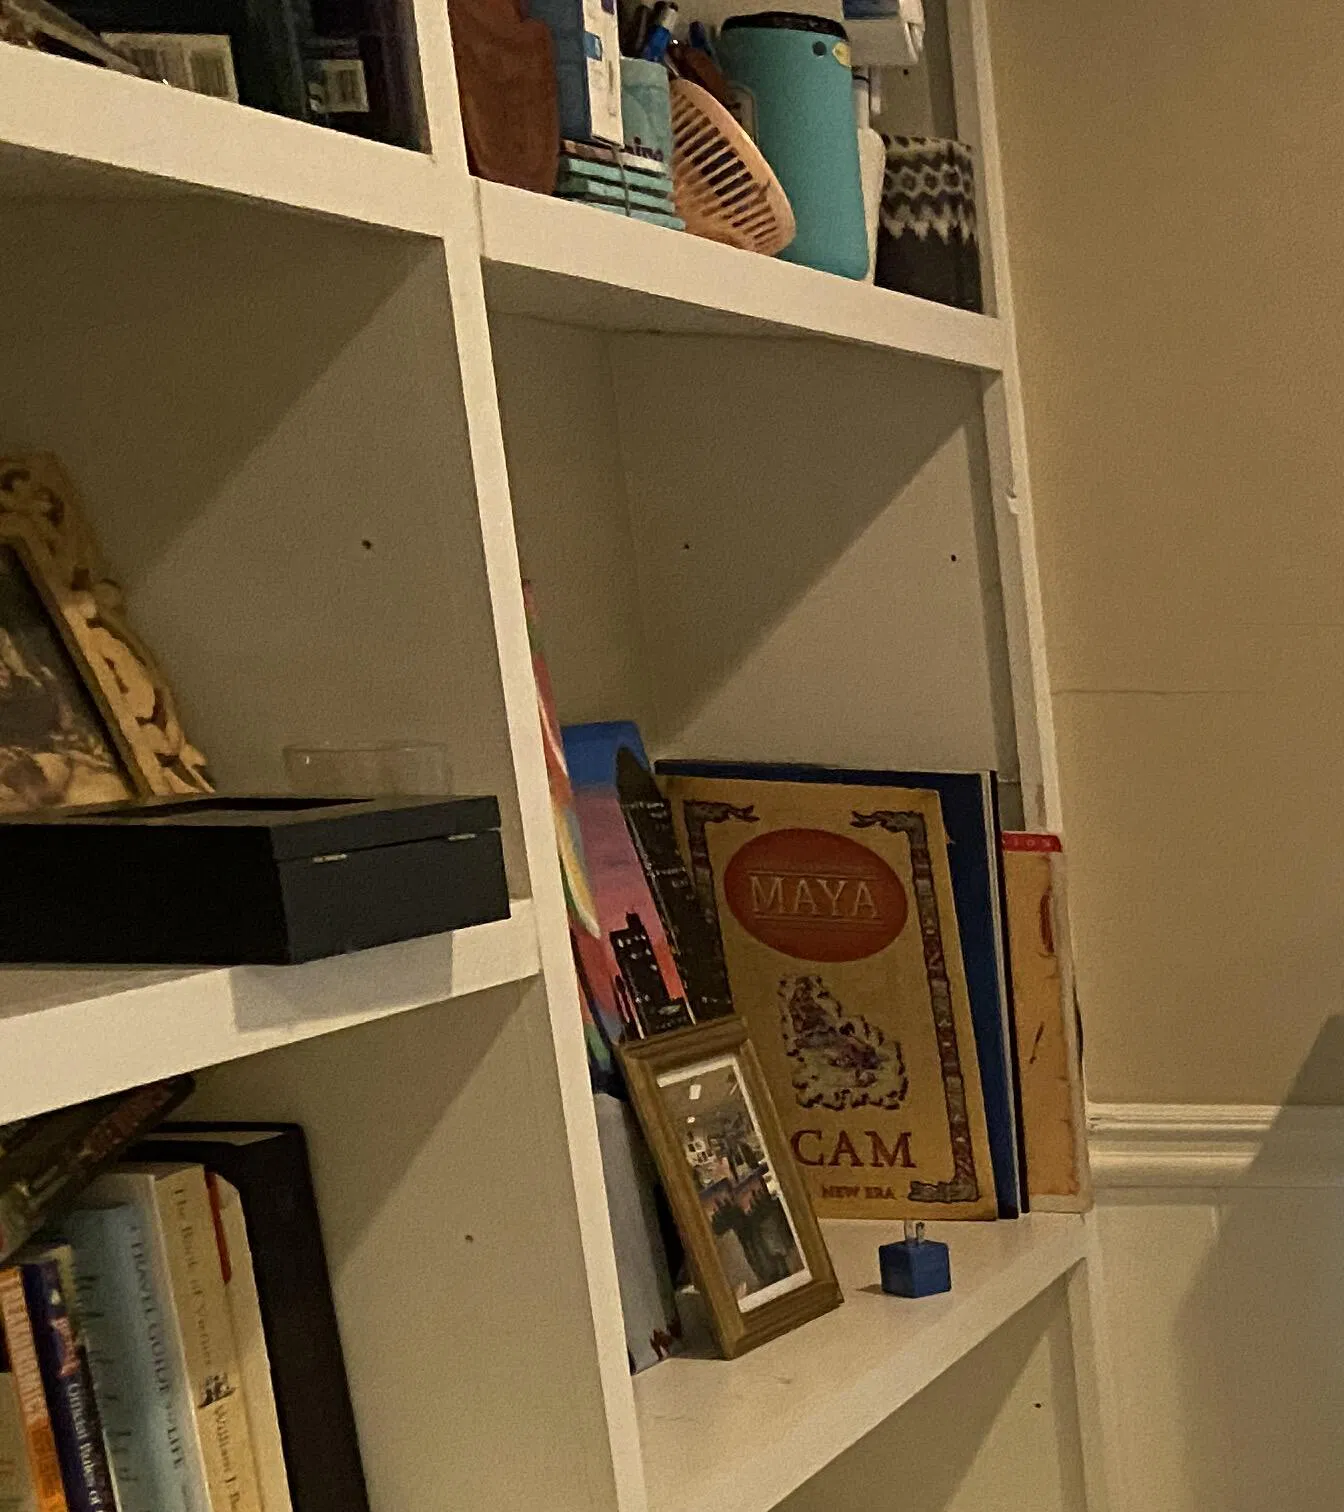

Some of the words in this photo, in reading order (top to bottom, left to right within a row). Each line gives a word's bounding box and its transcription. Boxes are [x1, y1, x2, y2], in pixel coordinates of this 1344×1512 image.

[750, 875, 882, 918] MAYA
[790, 1129, 917, 1168] CAM
[821, 1184, 861, 1199] NEW
